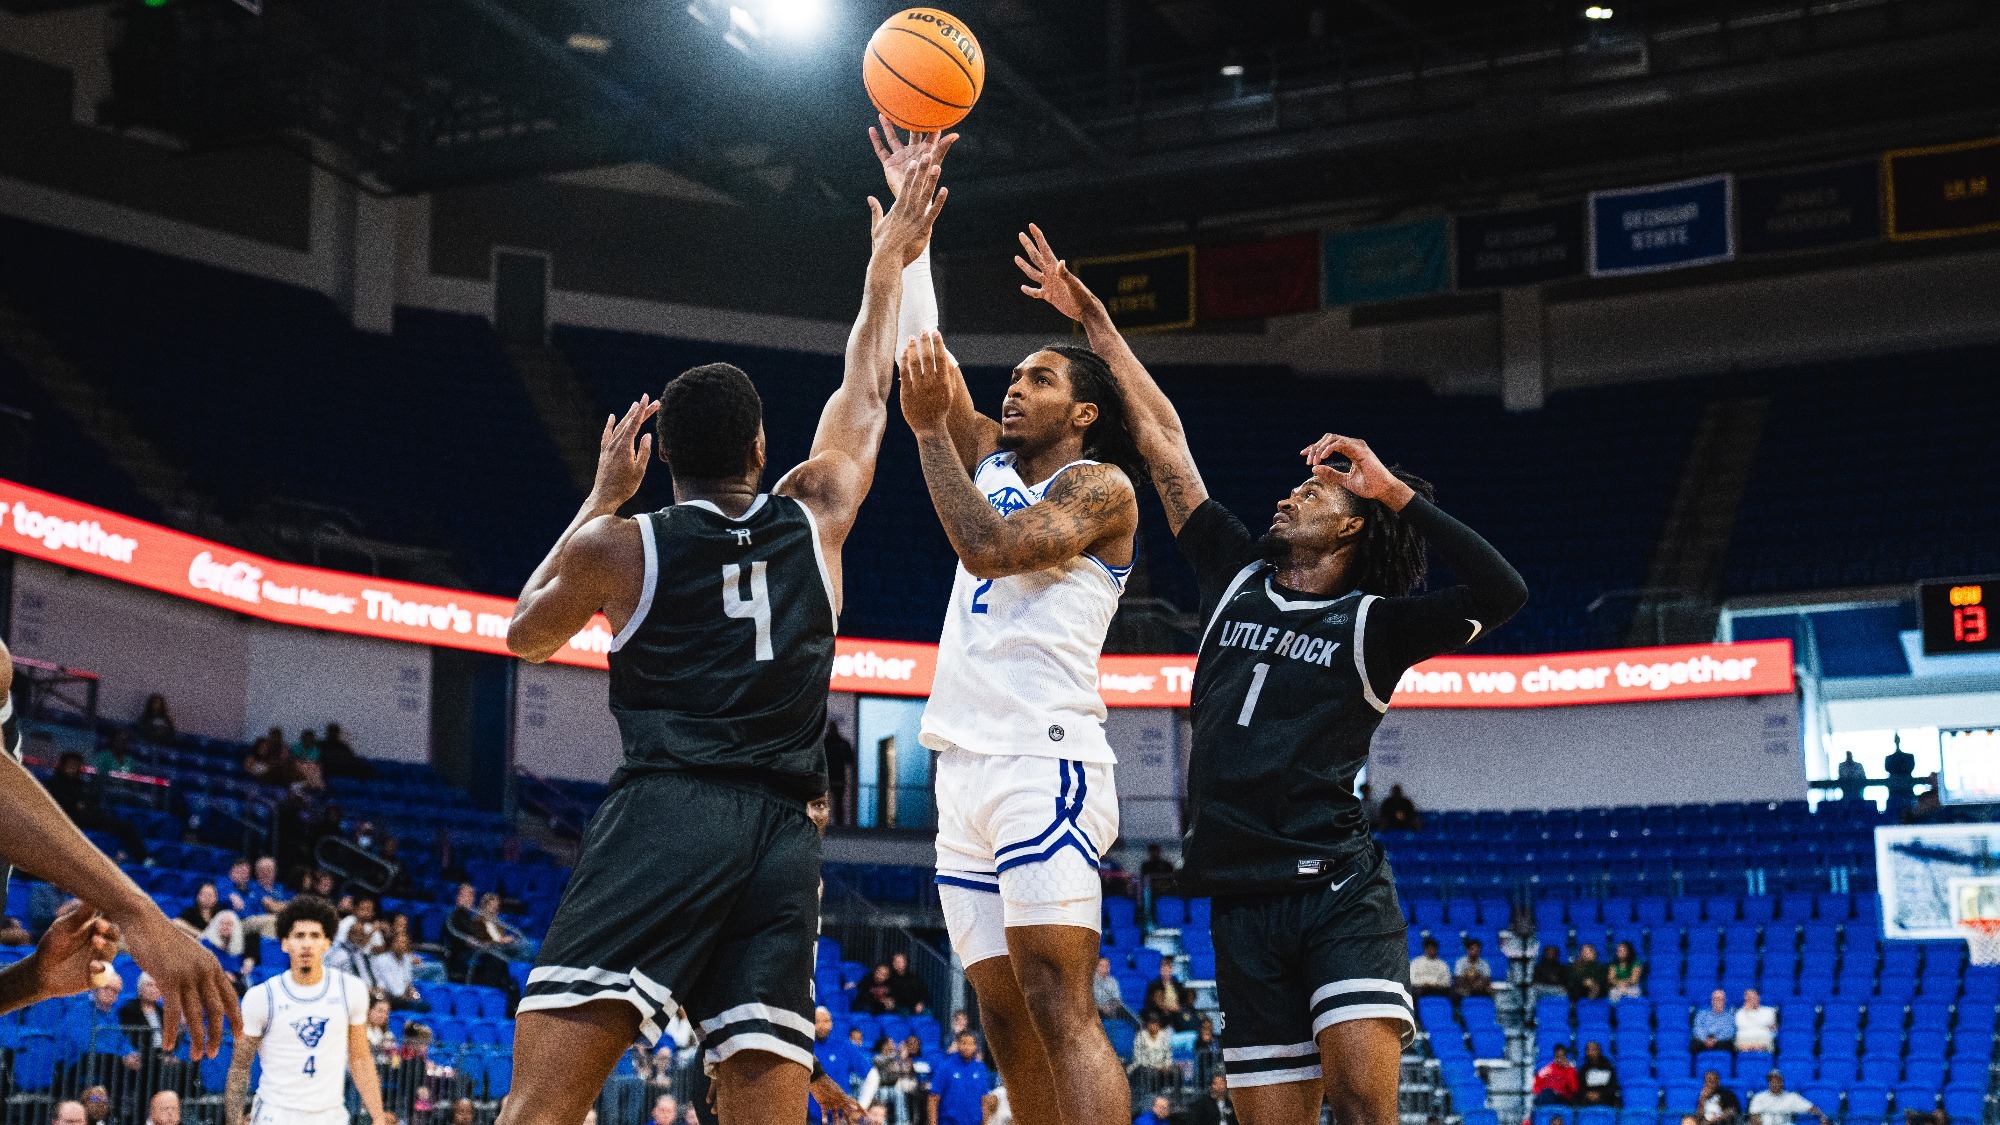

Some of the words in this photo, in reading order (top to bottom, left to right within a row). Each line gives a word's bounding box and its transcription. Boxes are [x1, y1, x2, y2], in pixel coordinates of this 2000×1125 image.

[907, 12, 976, 66] Wilson
[12, 501, 138, 564] together
[361, 589, 472, 634] There's
[722, 561, 774, 662] 4
[1953, 605, 1988, 643] 13
[1218, 620, 1280, 651] LITTLE
[1273, 630, 1341, 668] ROCK
[1236, 662, 1271, 728] 1
[1466, 671, 1517, 693] we
[1521, 664, 1611, 692] cheer
[1614, 654, 1758, 690] together
[303, 1055, 316, 1078] 4
